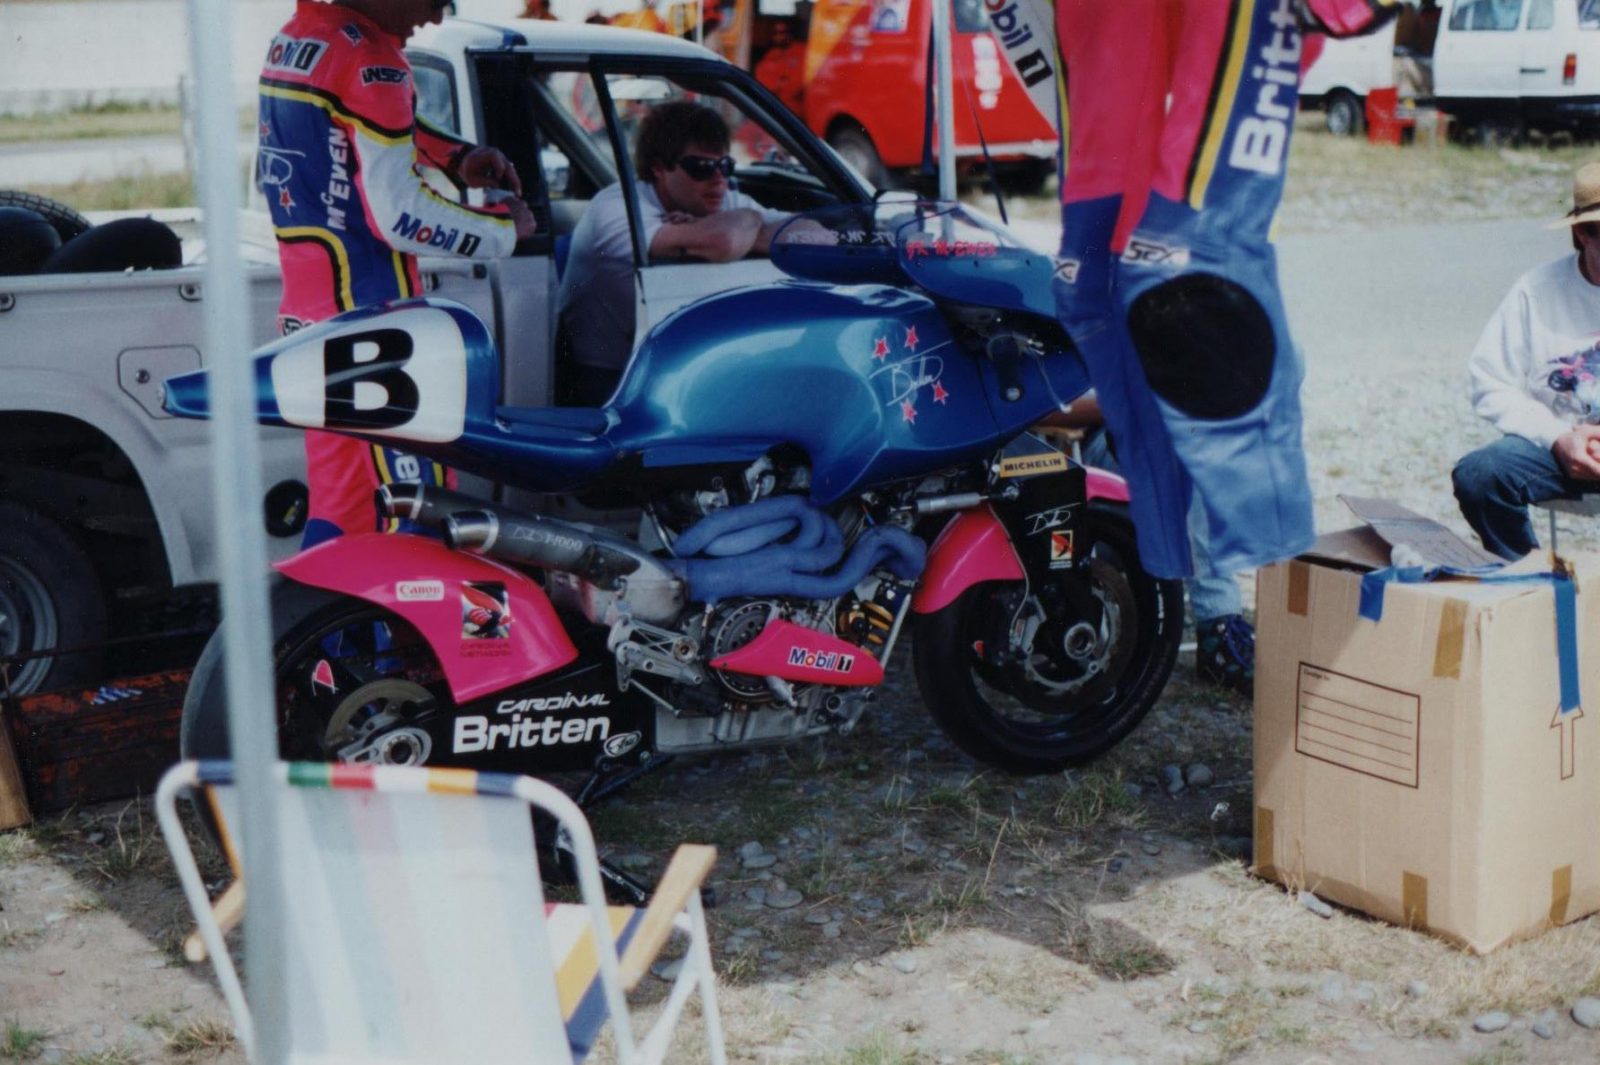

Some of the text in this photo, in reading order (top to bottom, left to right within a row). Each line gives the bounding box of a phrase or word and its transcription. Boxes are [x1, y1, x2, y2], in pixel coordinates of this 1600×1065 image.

[392, 212, 481, 257] Mobil 1
[324, 328, 420, 430] B
[1004, 457, 1062, 472] MICHELIN
[400, 584, 441, 597] Canon
[790, 647, 853, 672] Mobil 1
[453, 713, 611, 754] Britten
